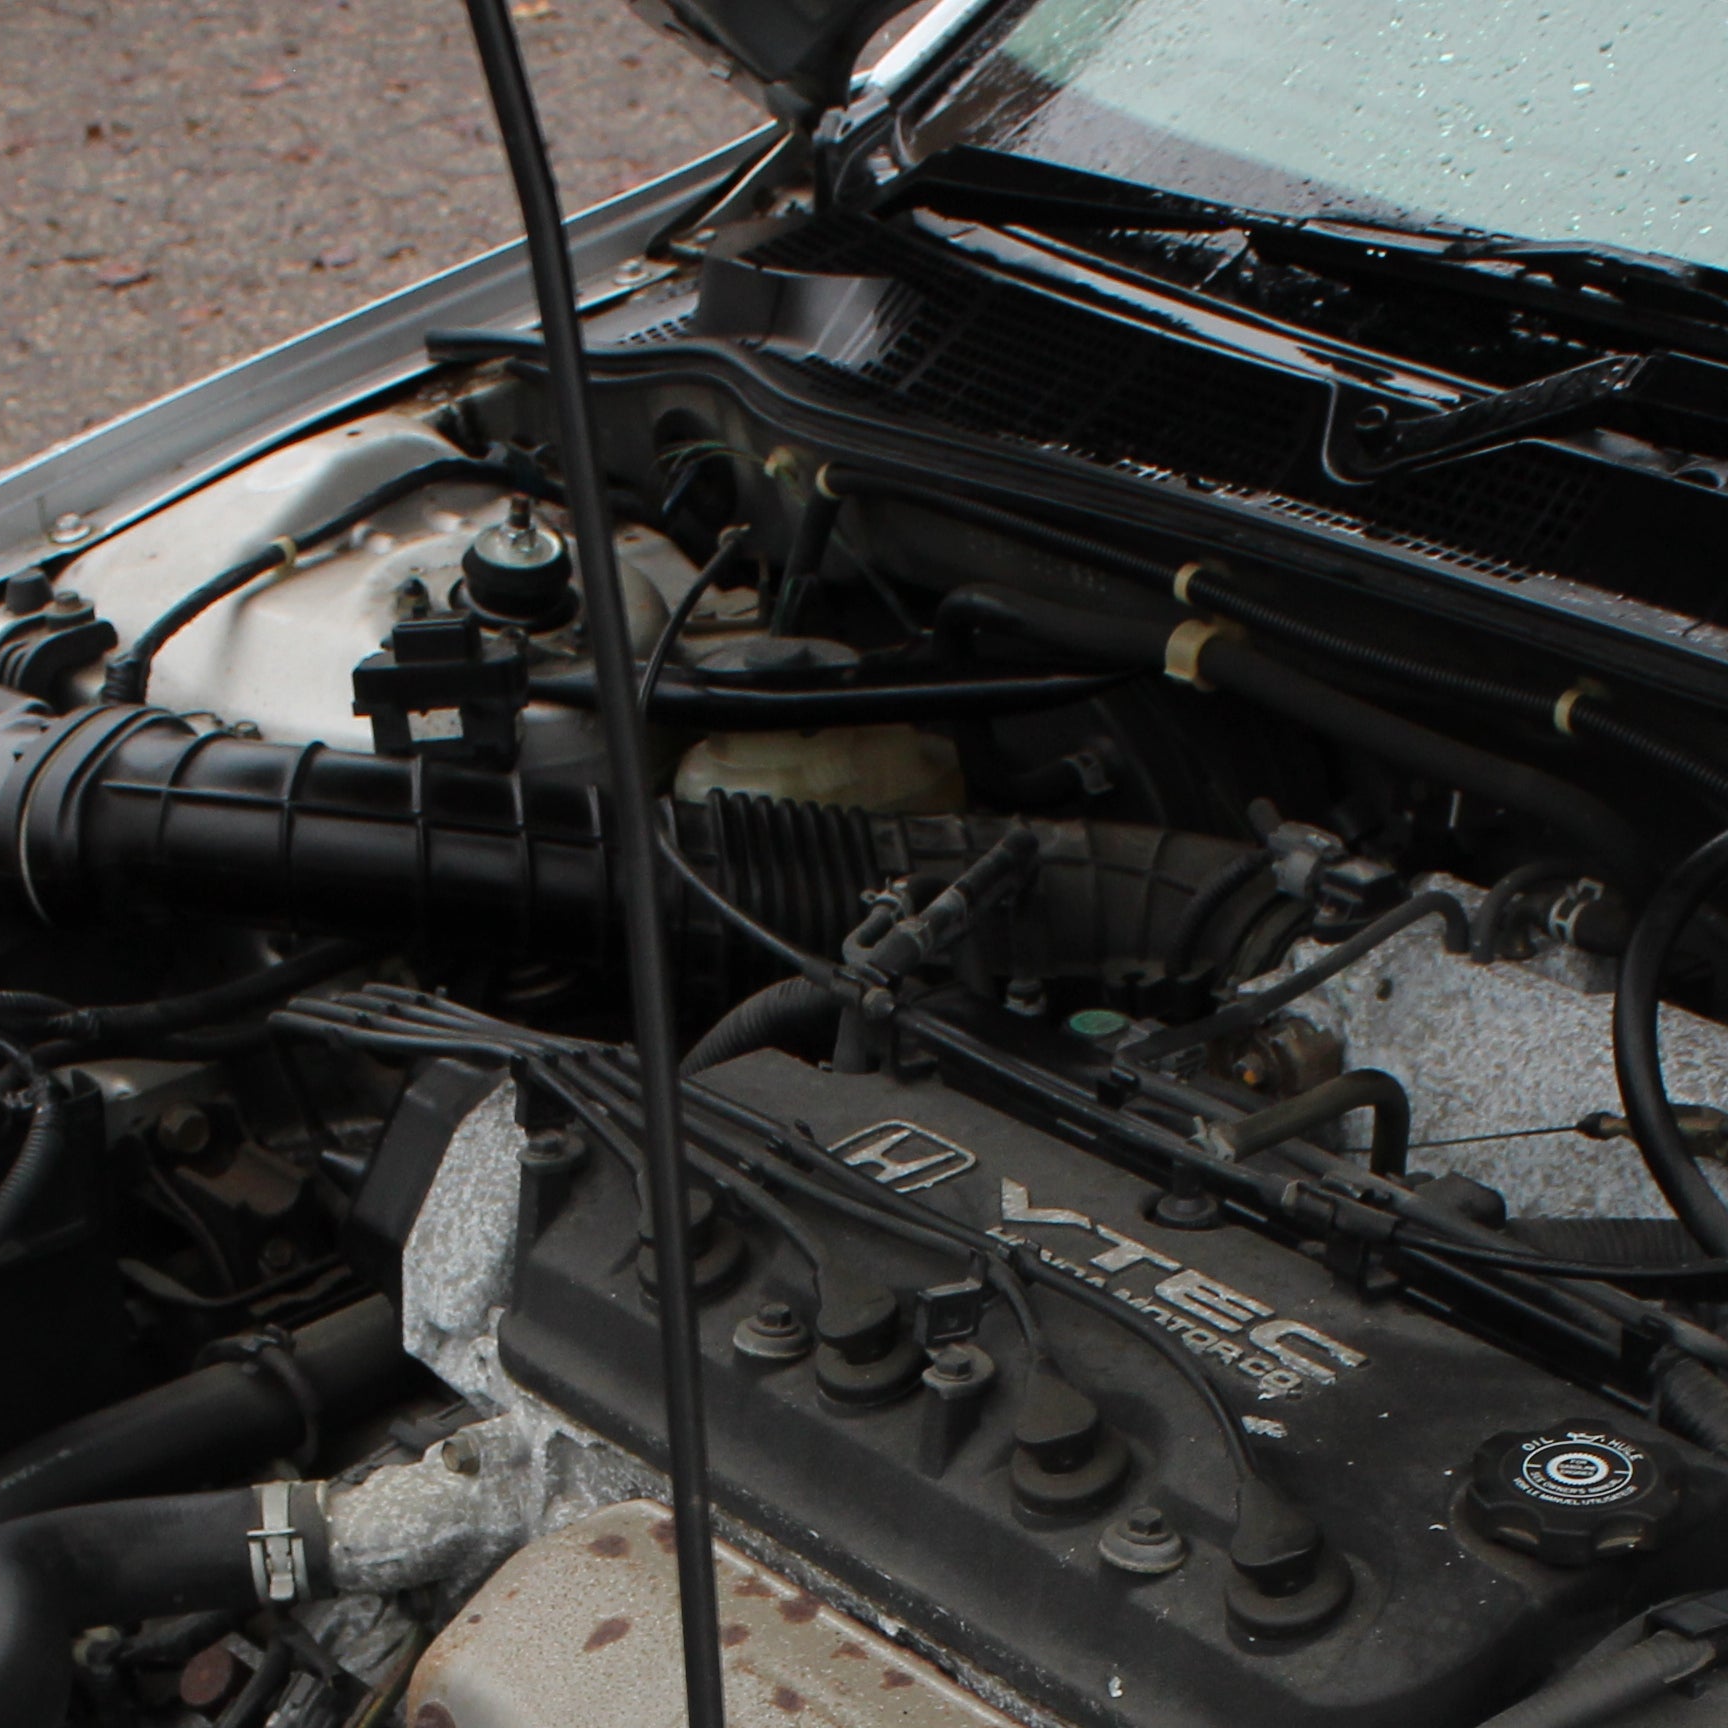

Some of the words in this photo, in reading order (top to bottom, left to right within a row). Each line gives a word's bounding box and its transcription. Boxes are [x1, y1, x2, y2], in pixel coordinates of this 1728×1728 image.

[1000, 1177, 1370, 1385] VTEC
[1521, 1436, 1554, 1452] OIL
[1608, 1439, 1645, 1462] HUILE
[1538, 1492, 1581, 1506] MANUEL
